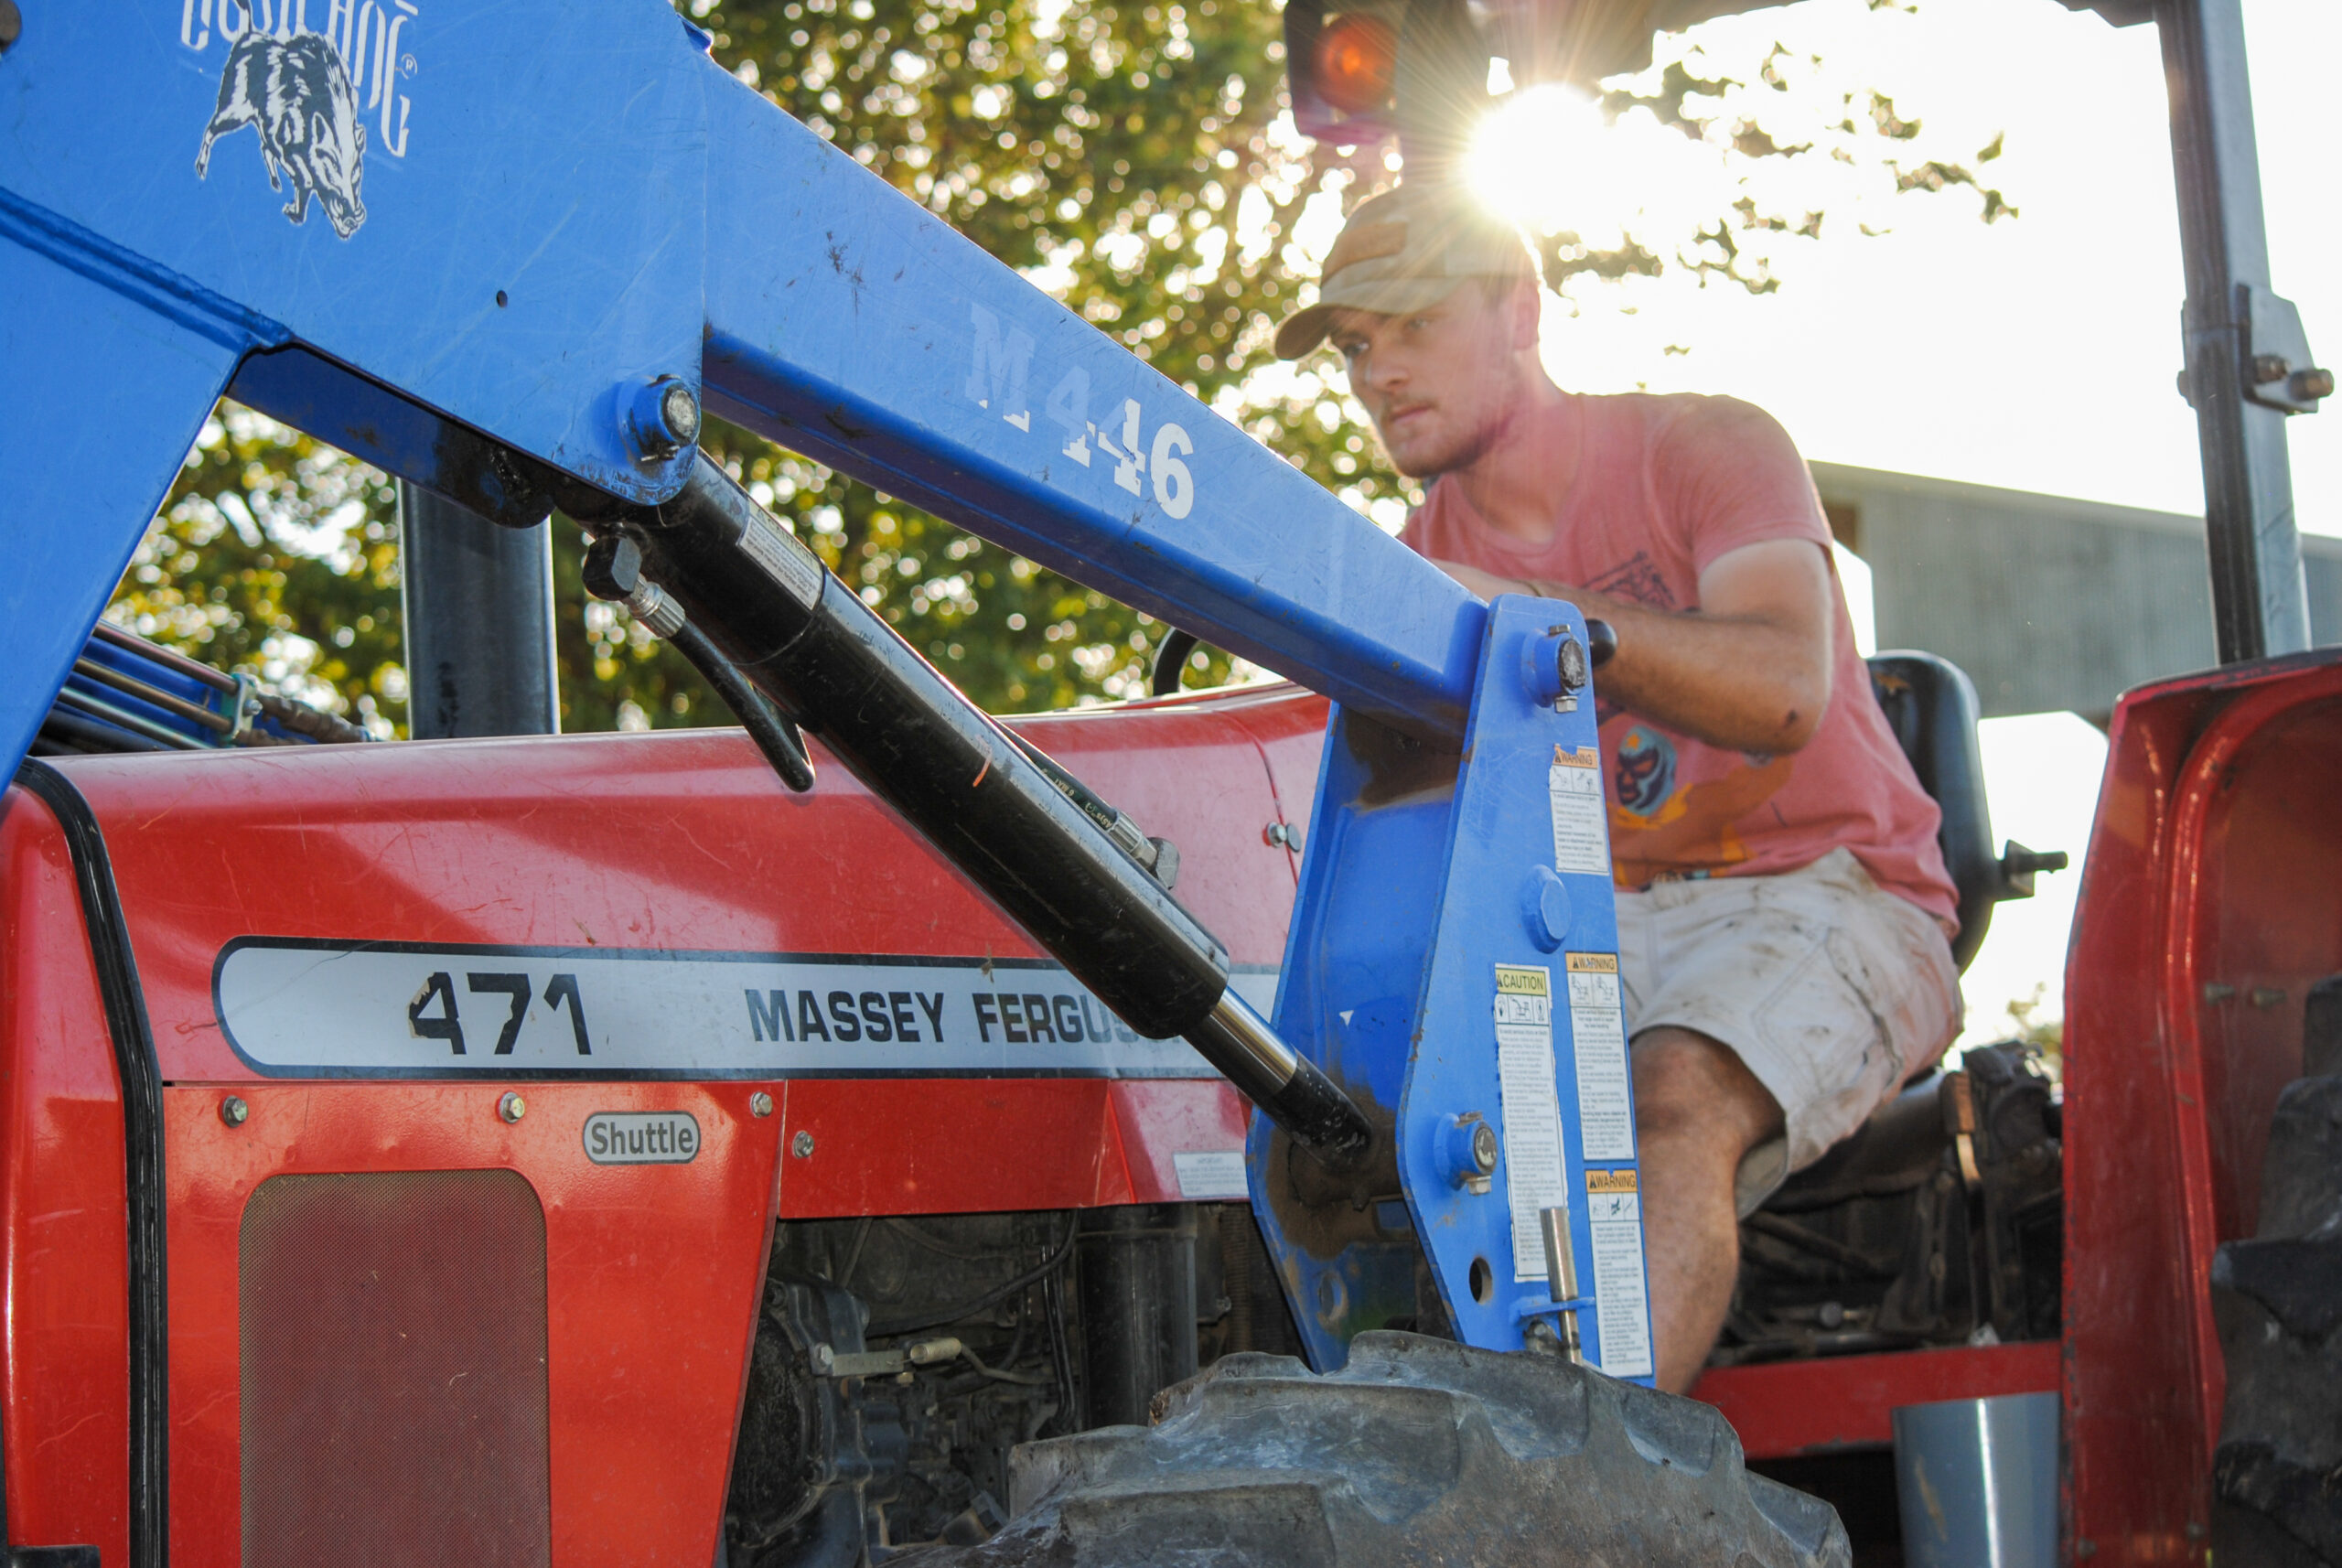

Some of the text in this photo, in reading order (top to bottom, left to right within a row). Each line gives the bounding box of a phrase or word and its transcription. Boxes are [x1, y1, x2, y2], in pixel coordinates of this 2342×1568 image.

[1563, 752, 1593, 766] WARNING
[1579, 957, 1615, 970] WARNING
[1503, 974, 1544, 991] CAUTION
[408, 972, 592, 1055] 471
[744, 989, 1180, 1044] MASSEY FERGU
[591, 1121, 693, 1155] Shuttle
[1595, 1175, 1636, 1188] WARNING
